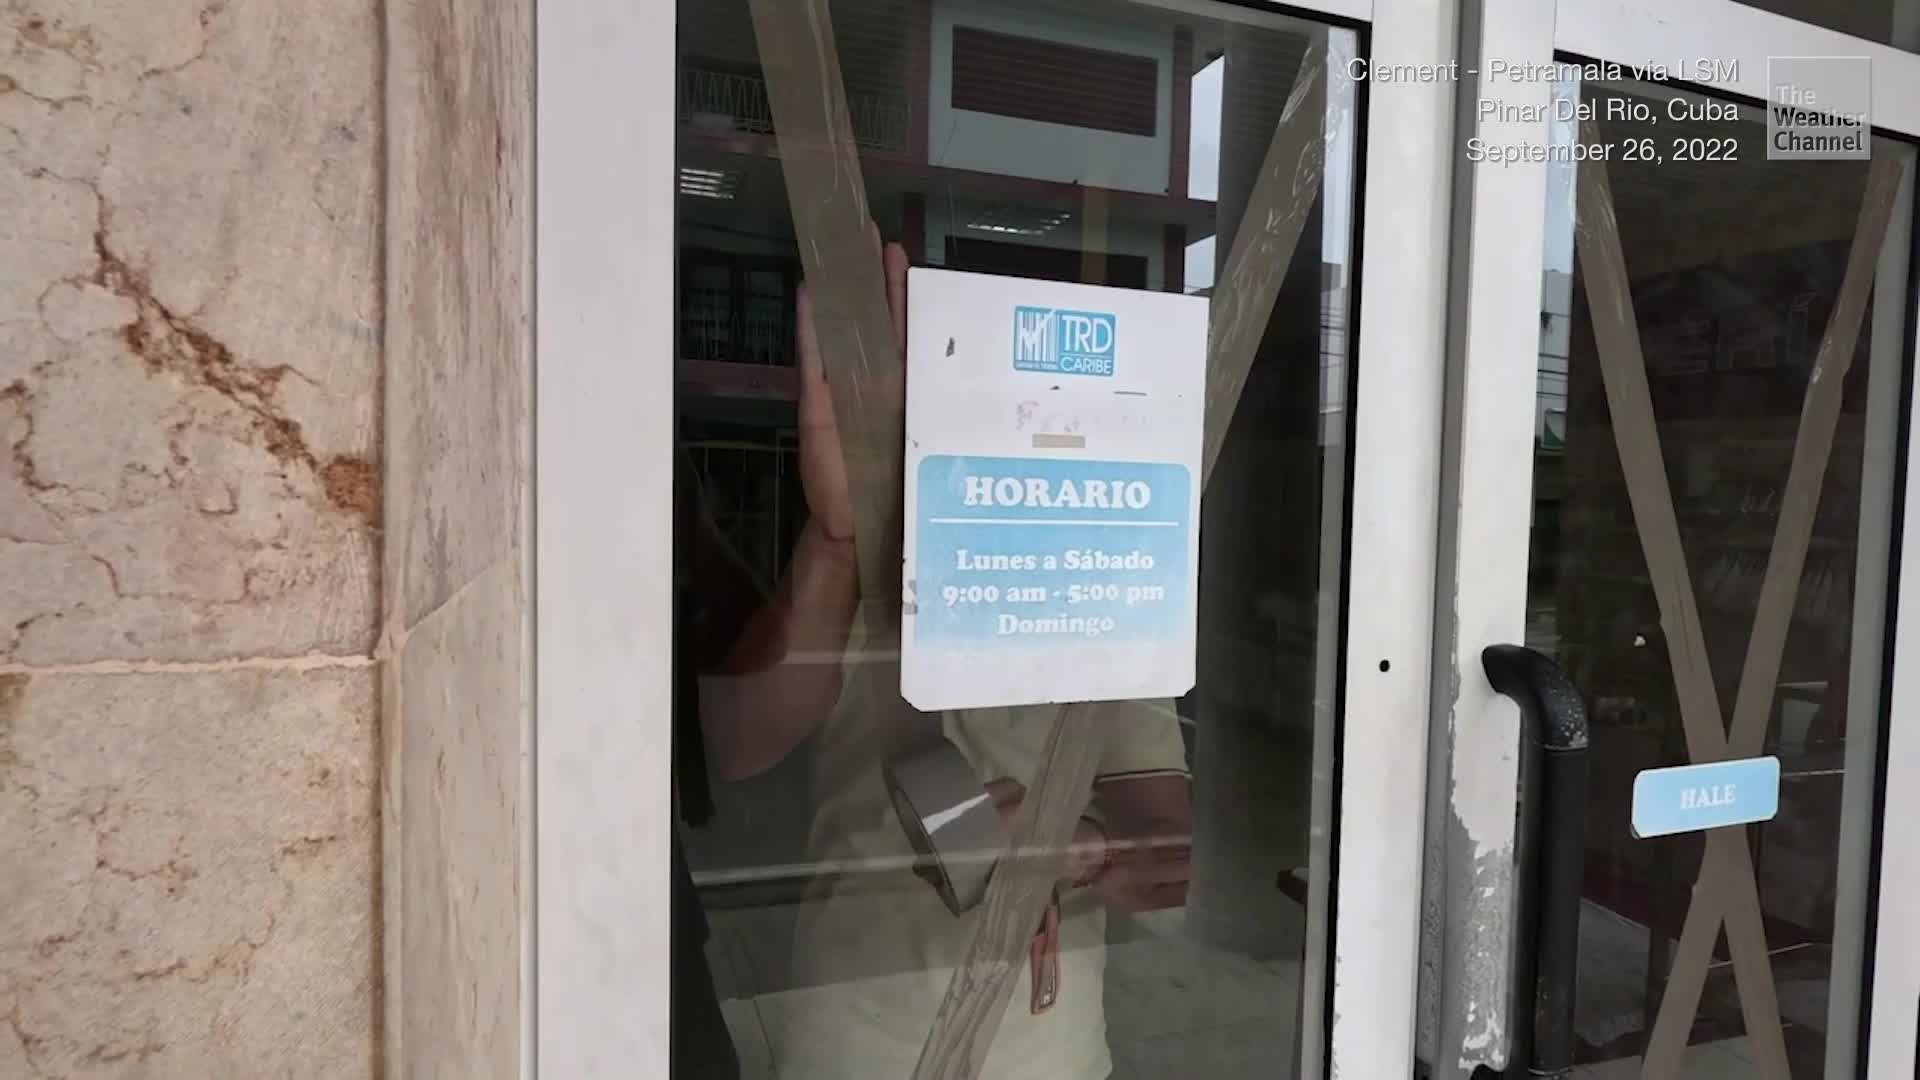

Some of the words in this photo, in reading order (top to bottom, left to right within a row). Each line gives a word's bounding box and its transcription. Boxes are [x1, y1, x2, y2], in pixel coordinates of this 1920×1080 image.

[1061, 315, 1113, 353] TRD
[1060, 356, 1112, 374] CARIBE
[963, 476, 1151, 509] HORARIO
[956, 550, 1037, 571] Lunes
[1043, 554, 1057, 570] a
[1063, 549, 1155, 571] Sábado
[942, 585, 999, 607] 9:00
[1006, 586, 1047, 602] am
[1066, 584, 1119, 604] 5:00
[1125, 585, 1165, 605] pm
[997, 613, 1115, 637] Domingo
[1680, 784, 1737, 810] HALE
